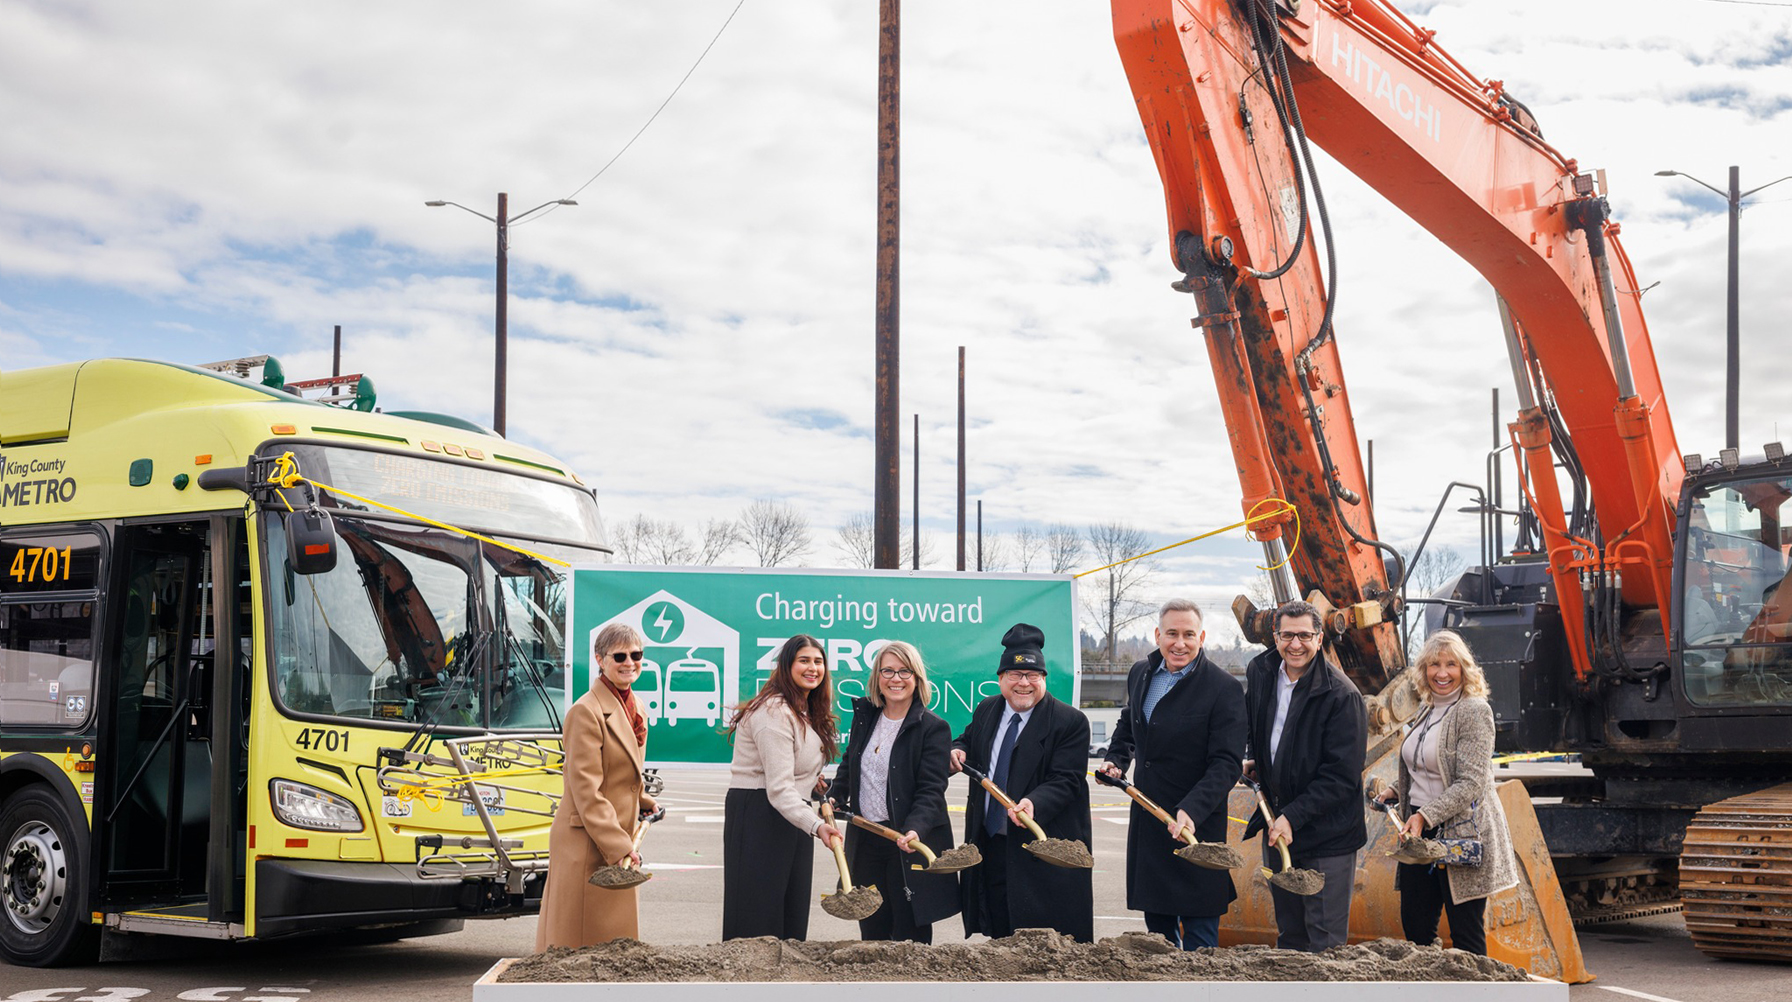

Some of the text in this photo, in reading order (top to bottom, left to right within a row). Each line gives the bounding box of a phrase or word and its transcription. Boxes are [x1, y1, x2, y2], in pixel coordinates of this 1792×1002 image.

[1331, 32, 1440, 142] HITACHI
[6, 458, 66, 478] King County
[2, 477, 77, 507] METRO
[10, 545, 71, 583] 4701
[755, 592, 983, 629] Charging toward
[756, 637, 894, 672] ZR
[296, 728, 349, 752] 4701
[470, 756, 512, 769] METRO
